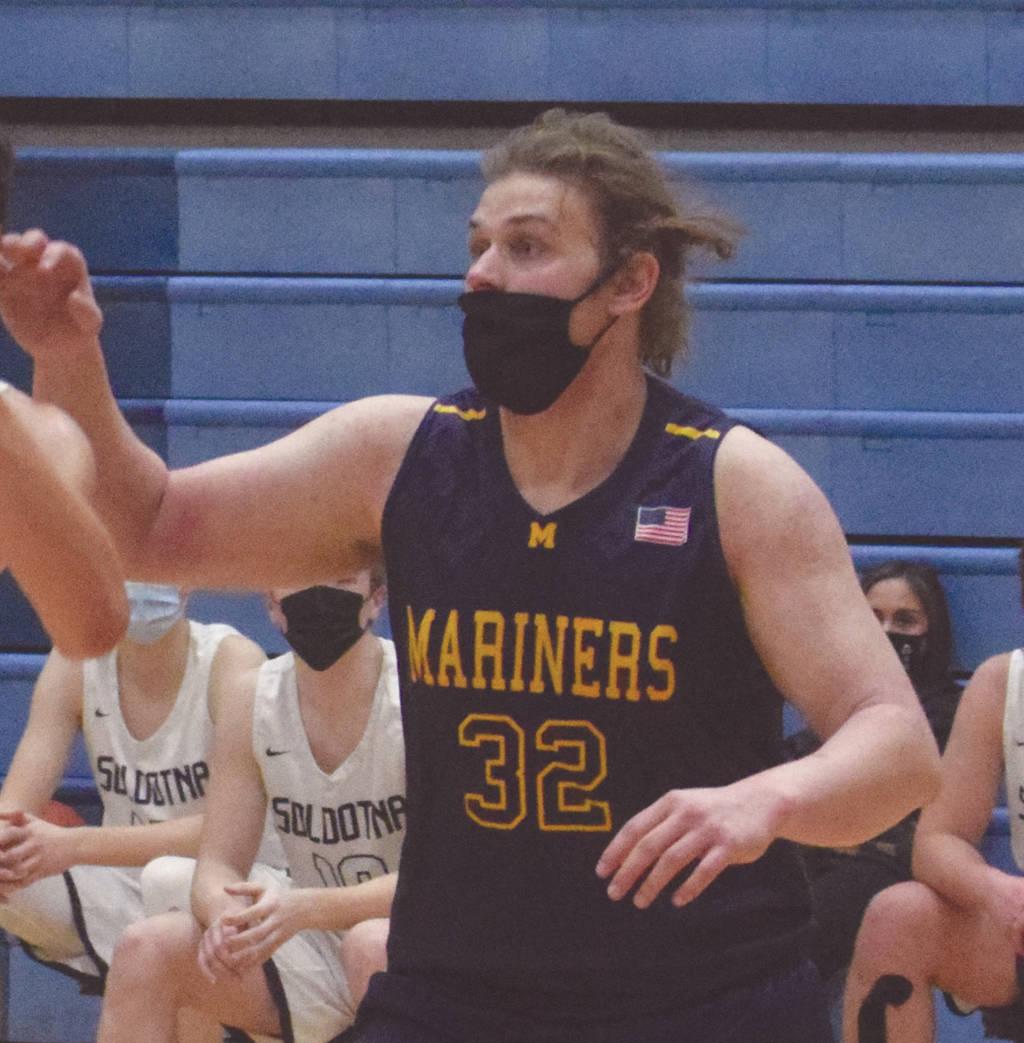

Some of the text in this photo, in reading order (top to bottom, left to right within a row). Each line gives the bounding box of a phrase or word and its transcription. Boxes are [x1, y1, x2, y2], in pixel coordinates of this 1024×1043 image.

[528, 521, 557, 549] M
[406, 604, 678, 702] MARINERS
[458, 713, 612, 831] 32
